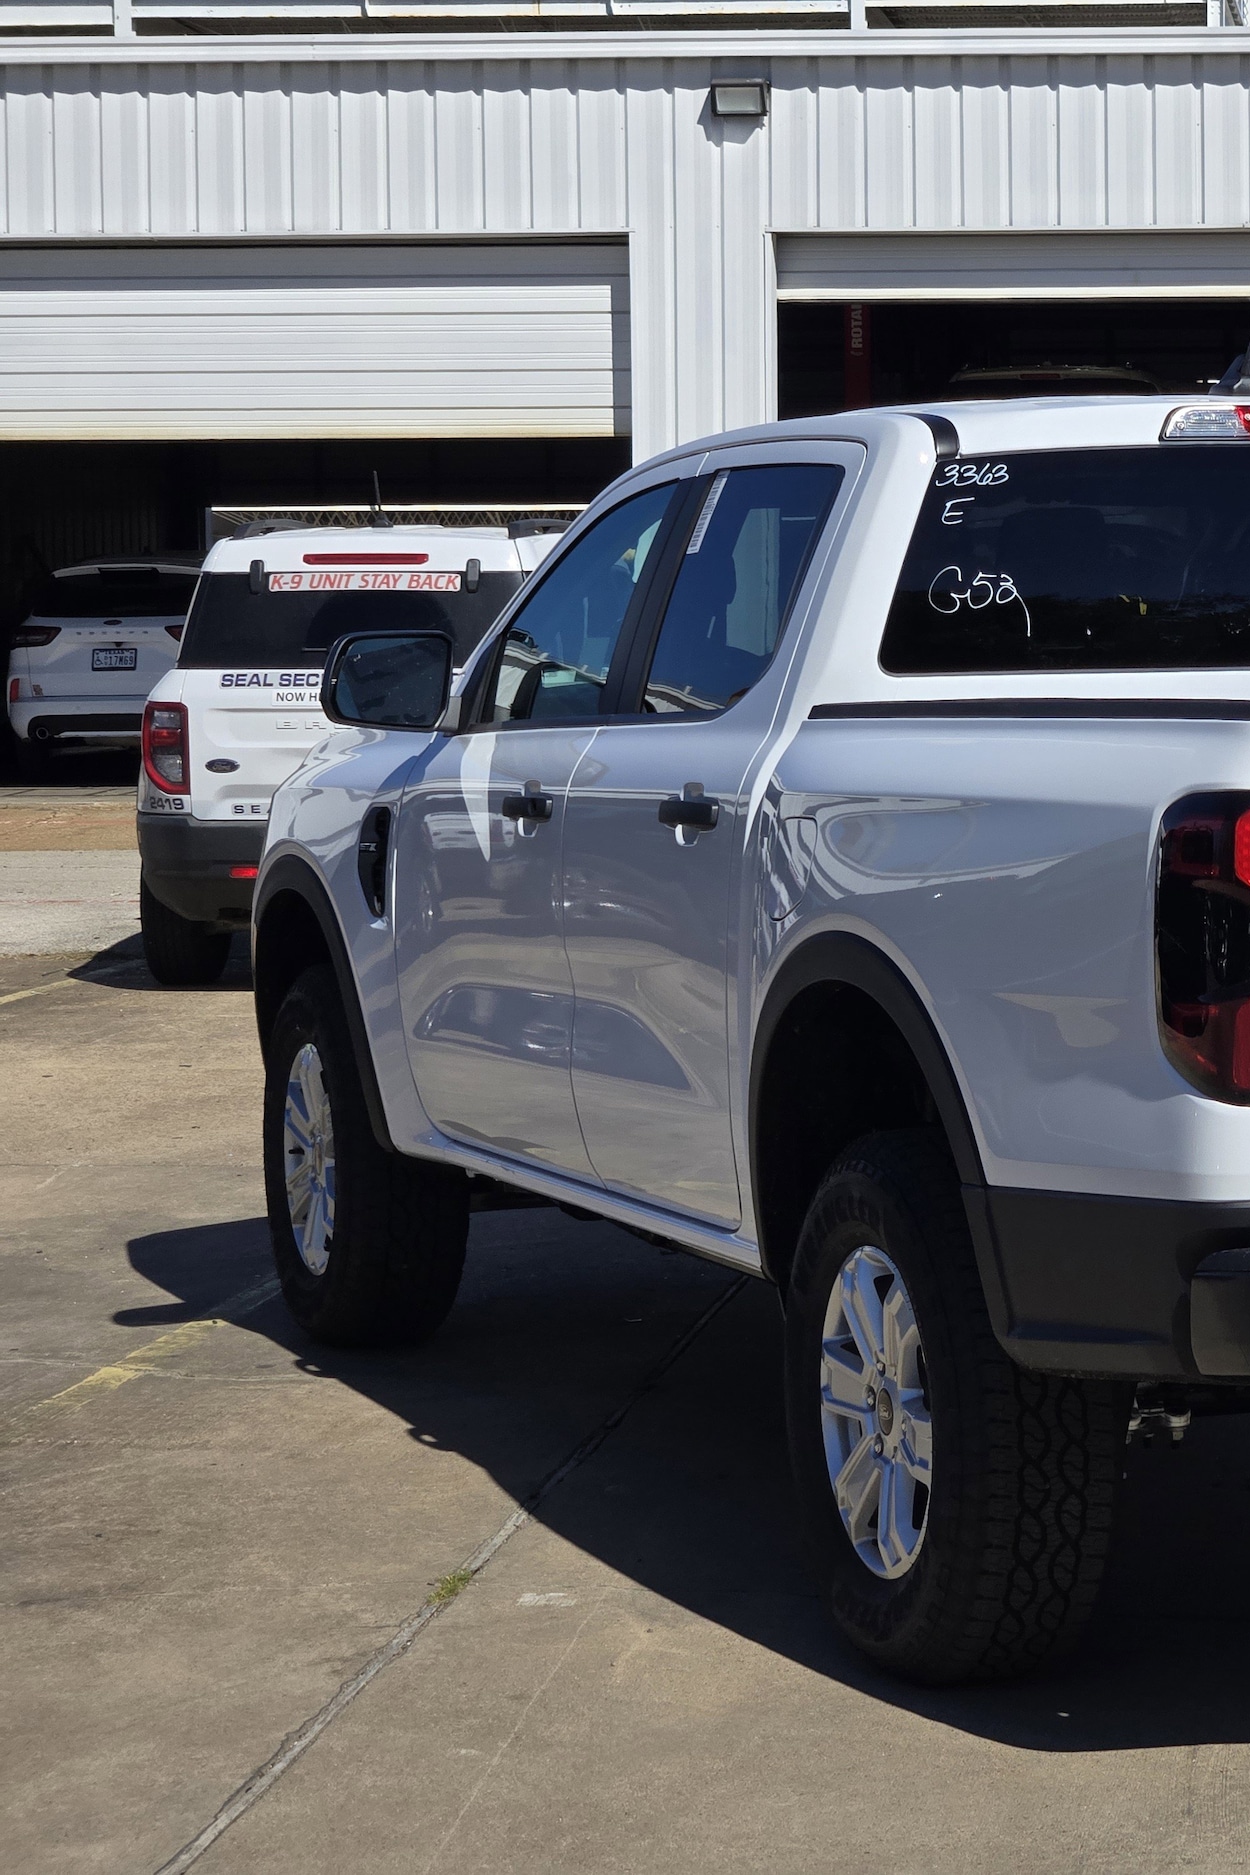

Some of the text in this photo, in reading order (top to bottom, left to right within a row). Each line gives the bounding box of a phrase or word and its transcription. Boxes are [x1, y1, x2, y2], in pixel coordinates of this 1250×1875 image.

[936, 463, 1010, 487] 3363
[941, 497, 976, 525] E
[270, 573, 459, 590] K-9 UNIT STAY BACK
[221, 673, 325, 688] SEAL SEC
[276, 692, 306, 702] NOW
[150, 796, 185, 811] 2419
